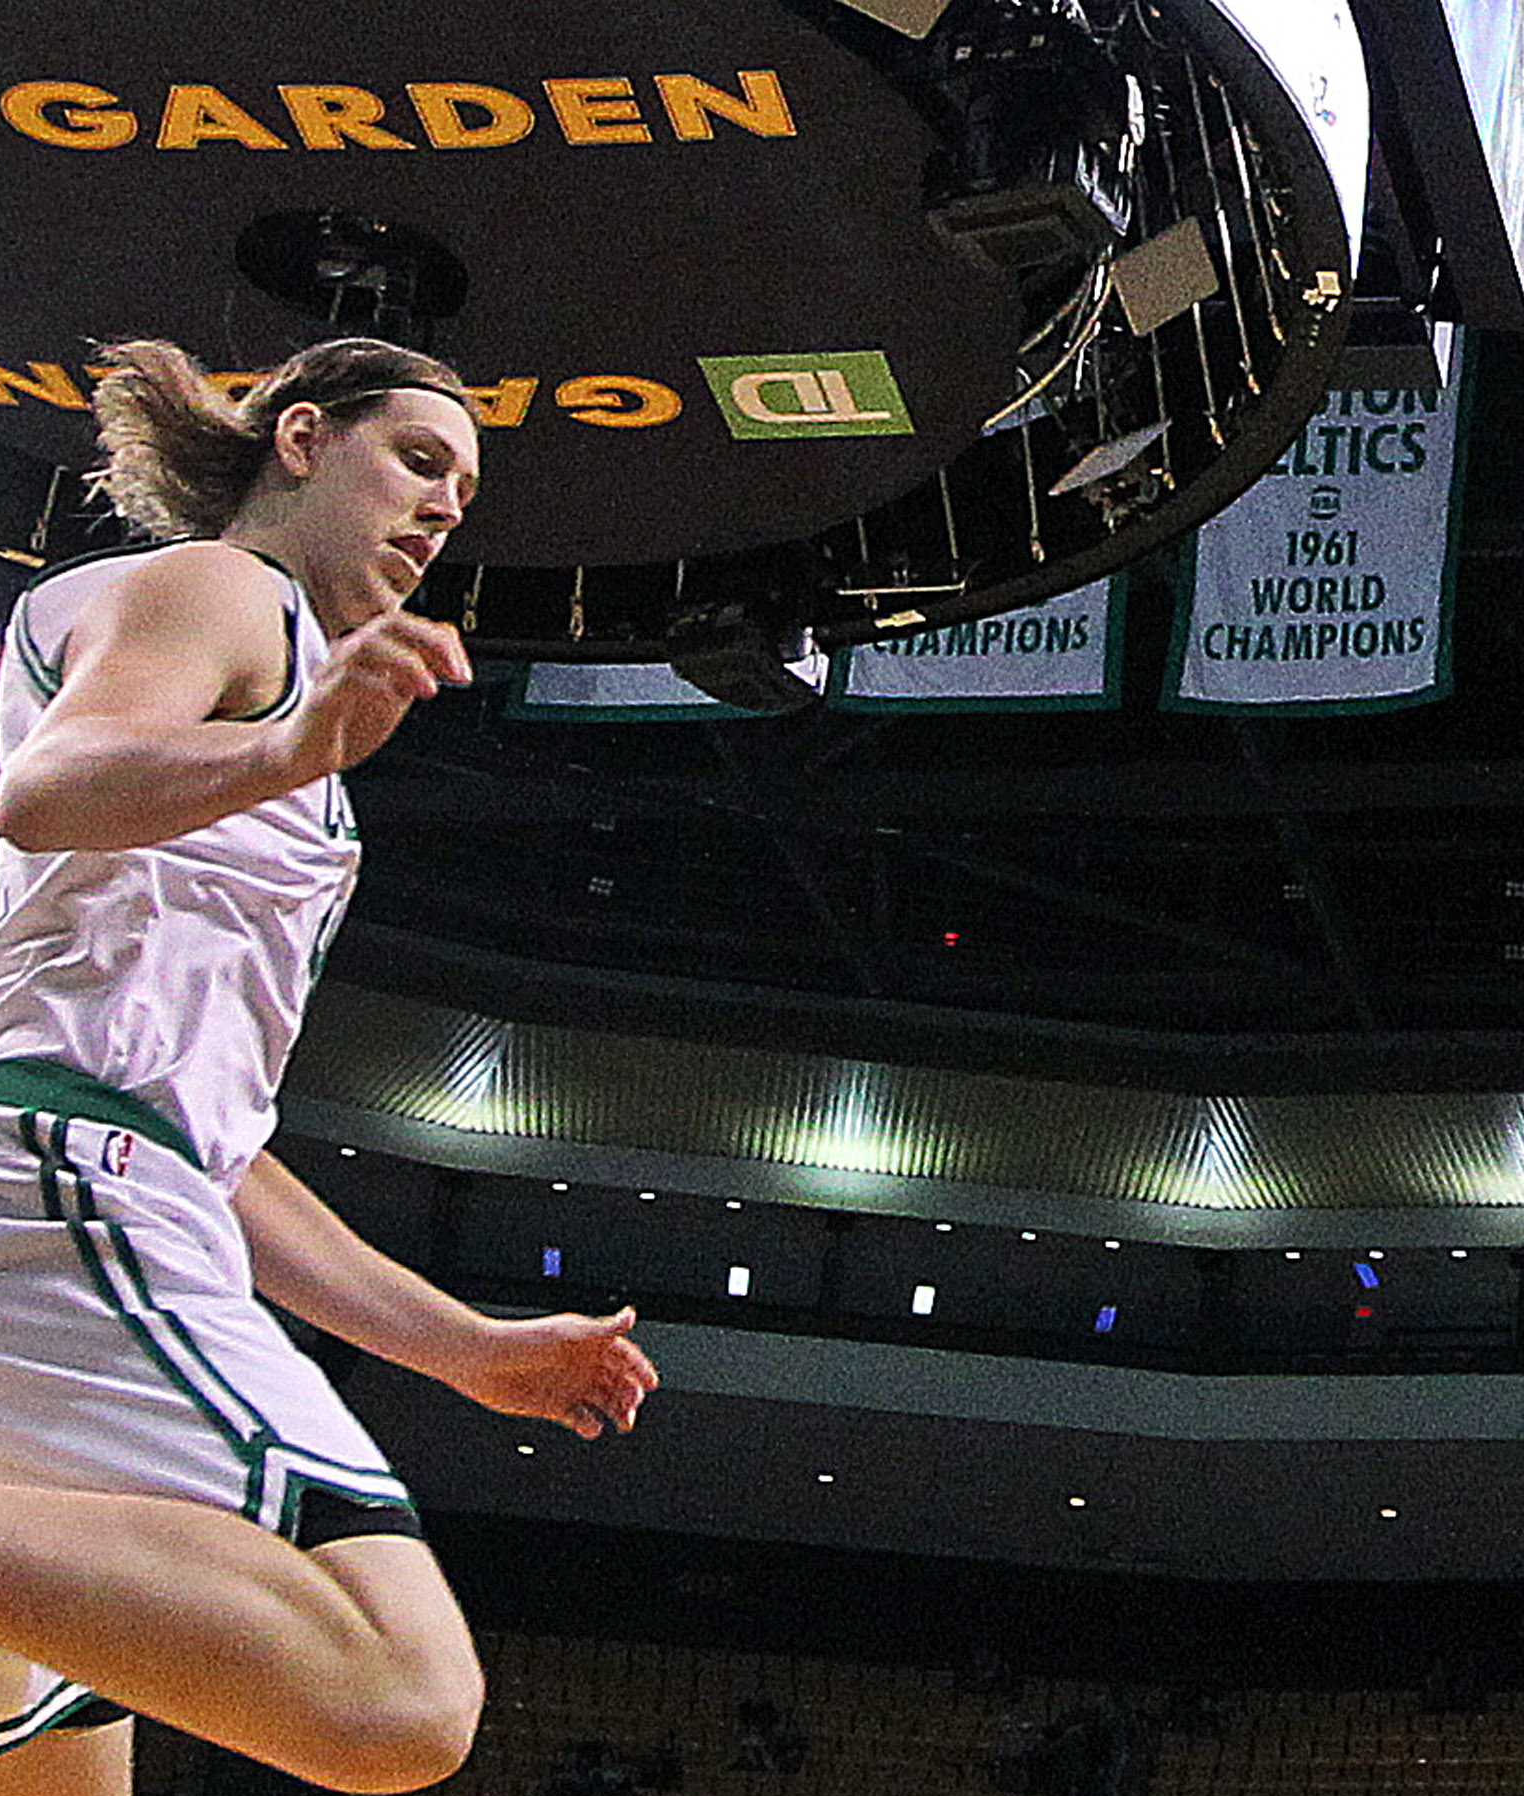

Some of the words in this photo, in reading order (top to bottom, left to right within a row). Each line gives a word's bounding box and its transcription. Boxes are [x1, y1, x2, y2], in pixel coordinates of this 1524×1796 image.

[0, 69, 798, 151] GARDEN
[1271, 423, 1427, 476] LTICS
[1286, 530, 1358, 566] 1961
[1251, 574, 1387, 616] WORLD
[874, 614, 1089, 657] AMPIONS
[1202, 617, 1426, 661] CHAMPIONS
